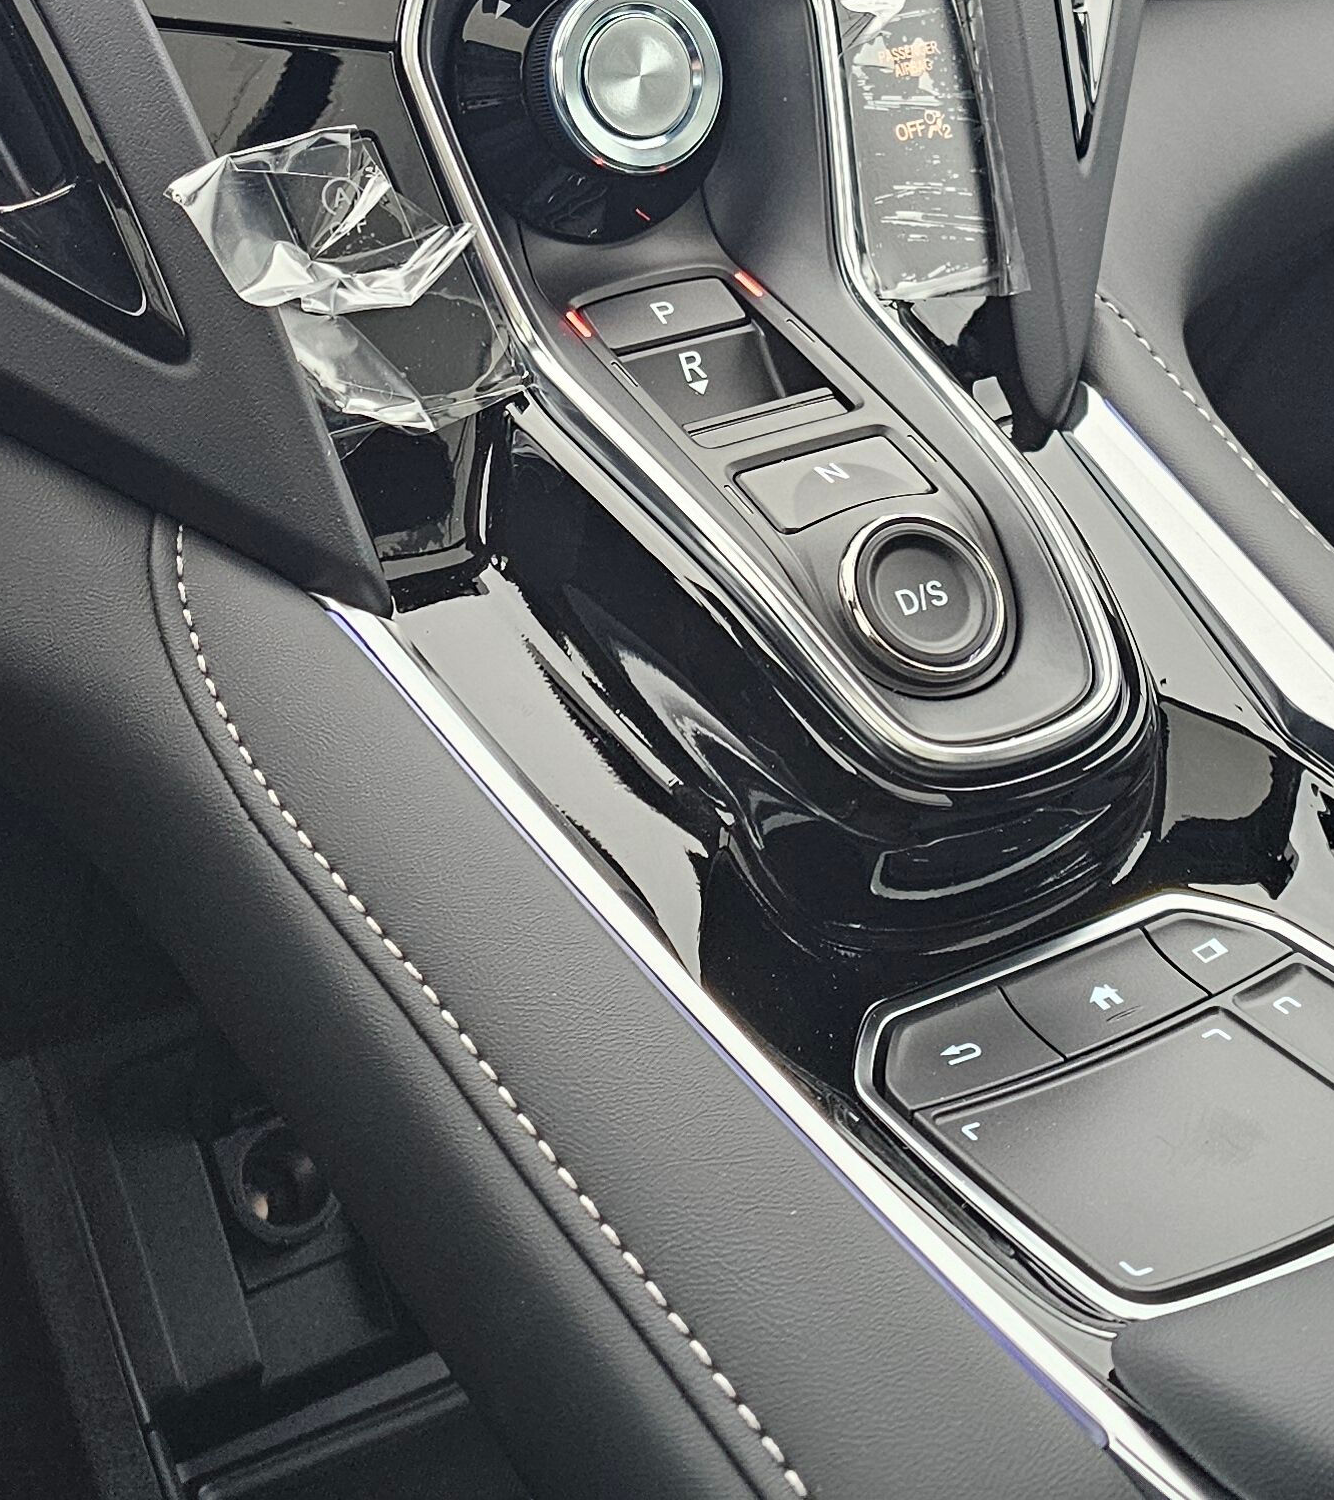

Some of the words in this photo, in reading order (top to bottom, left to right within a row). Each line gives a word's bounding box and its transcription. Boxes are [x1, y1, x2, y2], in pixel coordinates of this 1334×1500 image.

[879, 41, 941, 63] PASSEER
[895, 58, 933, 77] AIRG
[895, 119, 925, 141] OFF
[650, 301, 675, 325] P
[678, 350, 709, 382] R
[813, 462, 851, 484] N
[894, 580, 949, 616] D/S
